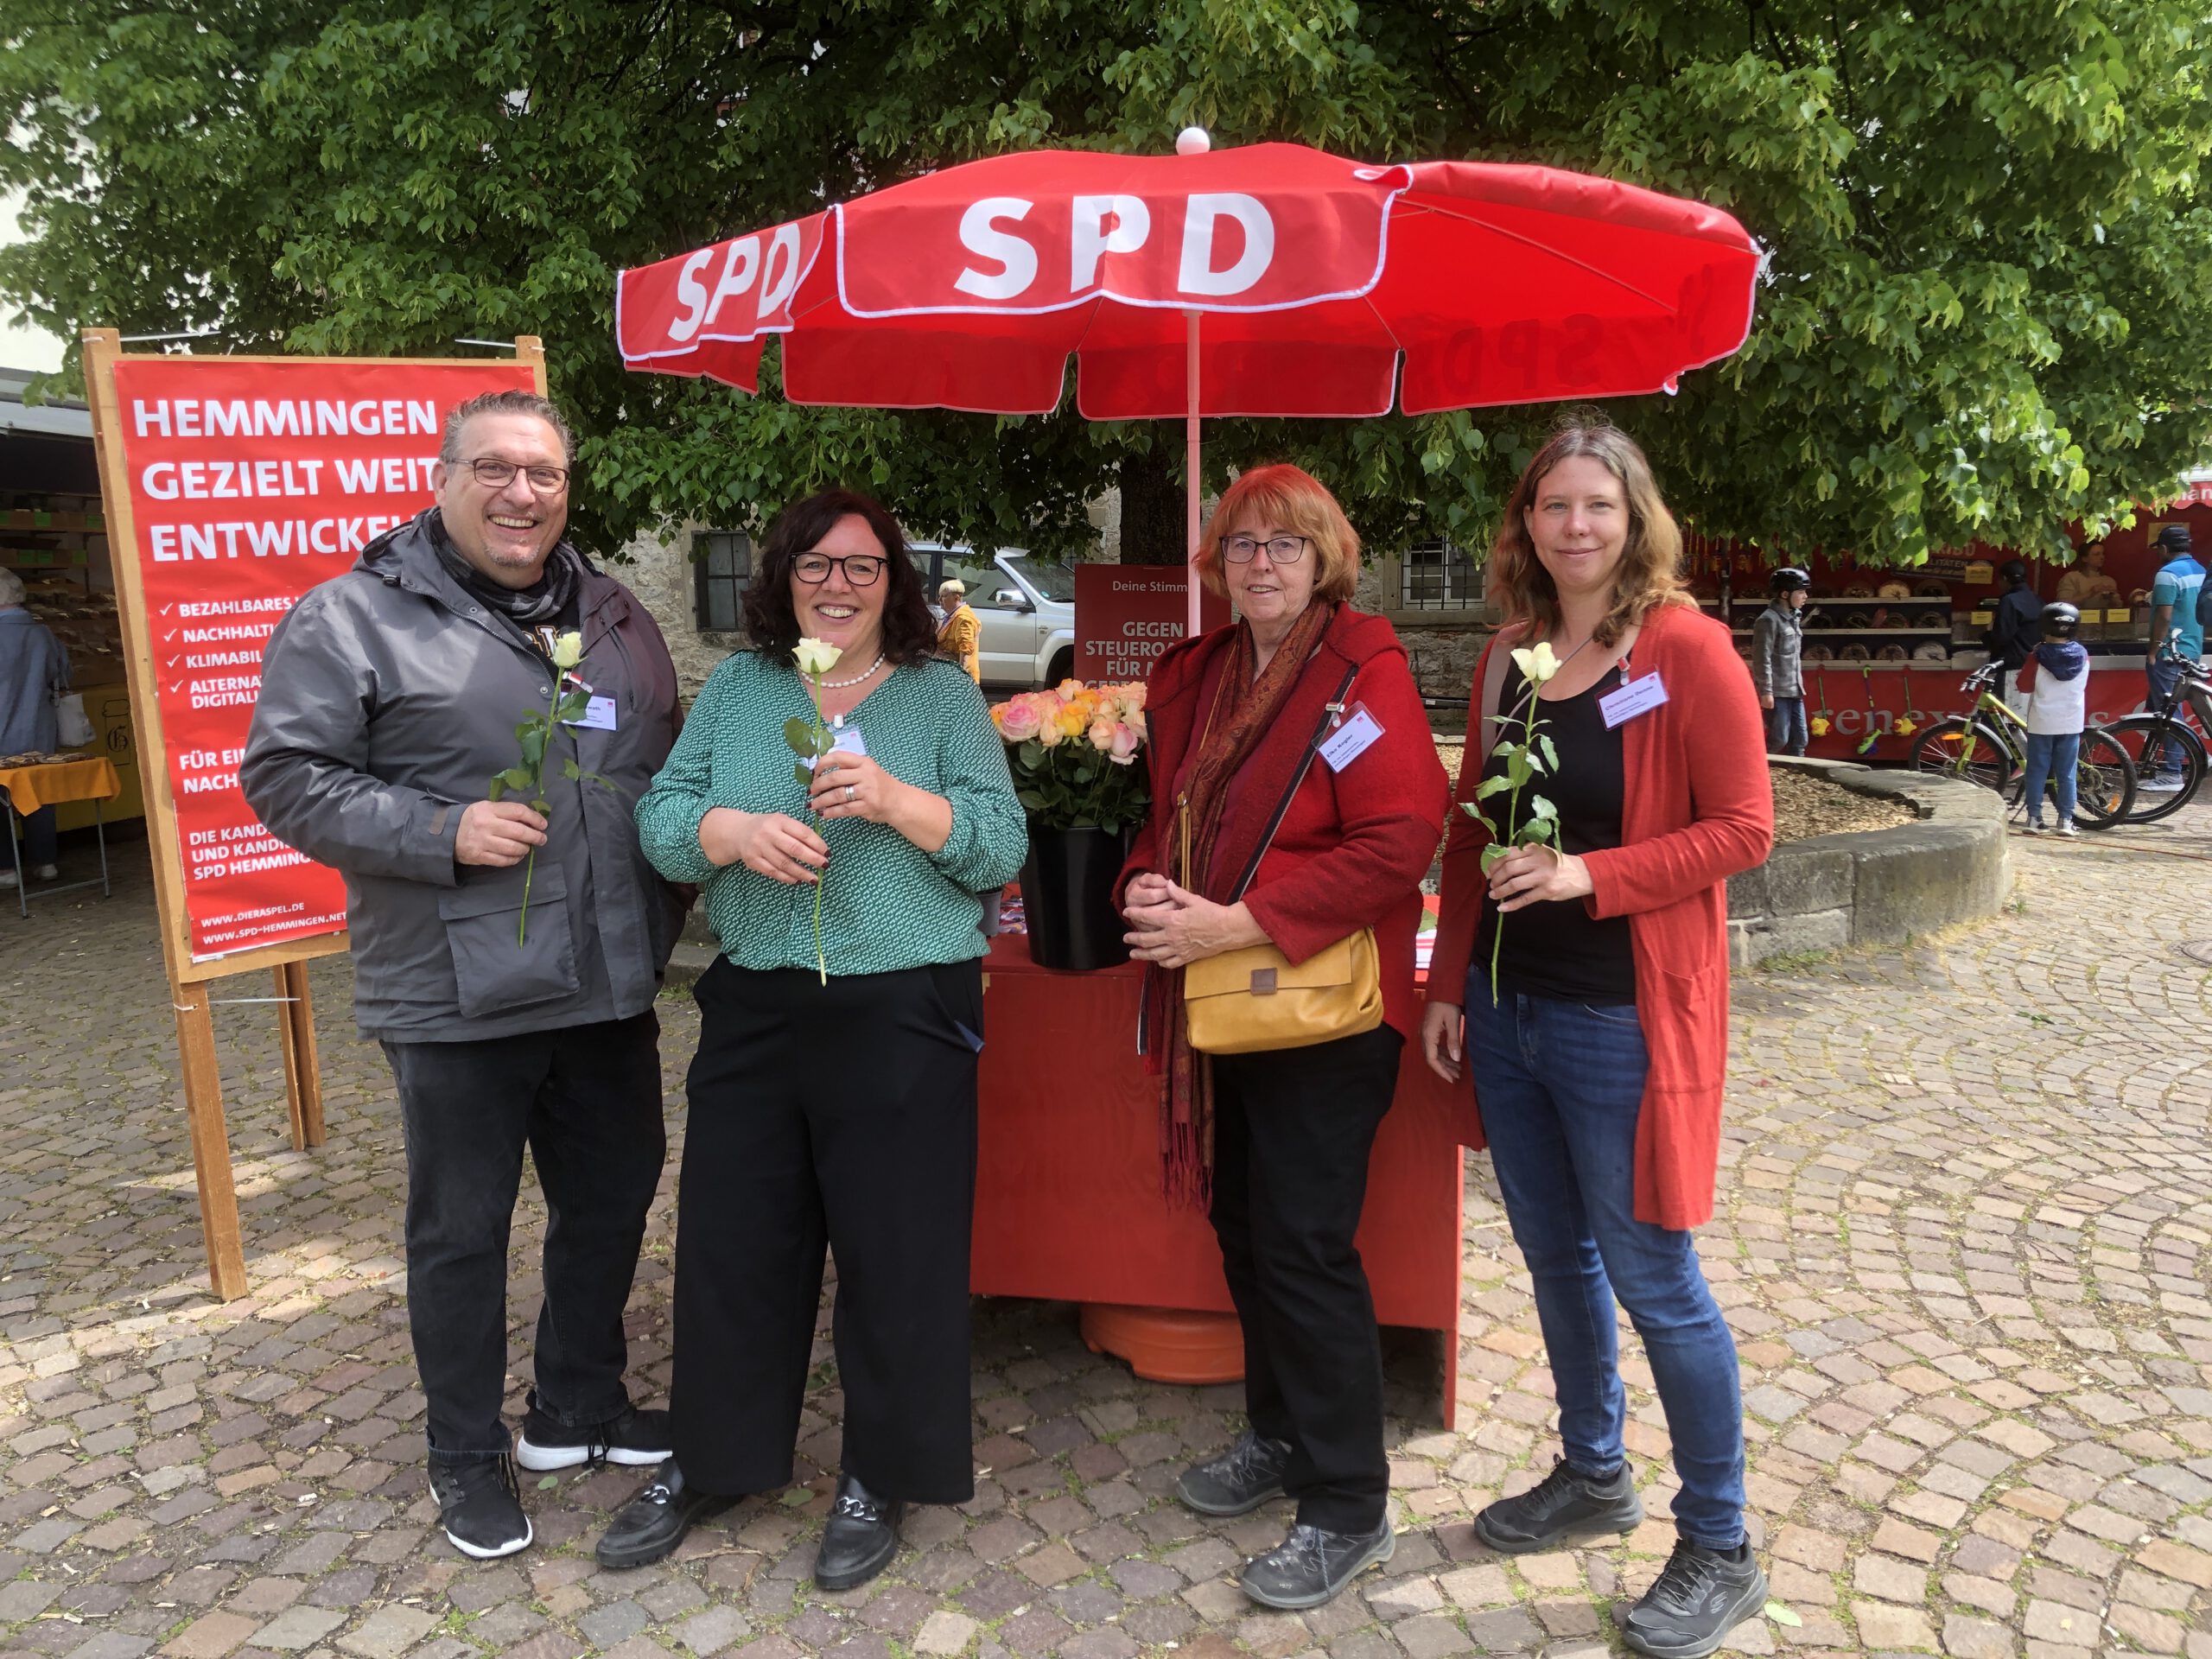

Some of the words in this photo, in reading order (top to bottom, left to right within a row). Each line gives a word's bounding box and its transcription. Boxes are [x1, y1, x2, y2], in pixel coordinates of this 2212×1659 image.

[954, 192, 1275, 300] SPD
[667, 222, 801, 342] SPD
[133, 399, 438, 437] HEMMINGEN
[143, 460, 324, 500] GEZIELT
[1112, 581, 1147, 592] Deine
[179, 597, 292, 617] BEZAHLBARES
[183, 624, 279, 643] NACHHALTI
[1122, 621, 1184, 638] GEGEN
[1106, 657, 1141, 677] FÜR
[190, 675, 263, 695] ALTERNA
[180, 750, 218, 771] FÜR
[189, 830, 217, 846] DIE
[192, 846, 229, 862] UND
[194, 864, 226, 880] SPD
[200, 902, 305, 928] WWW.DIERASPEL.DE
[202, 912, 347, 944] WWW.SPD-HEMMINGEN.NET
